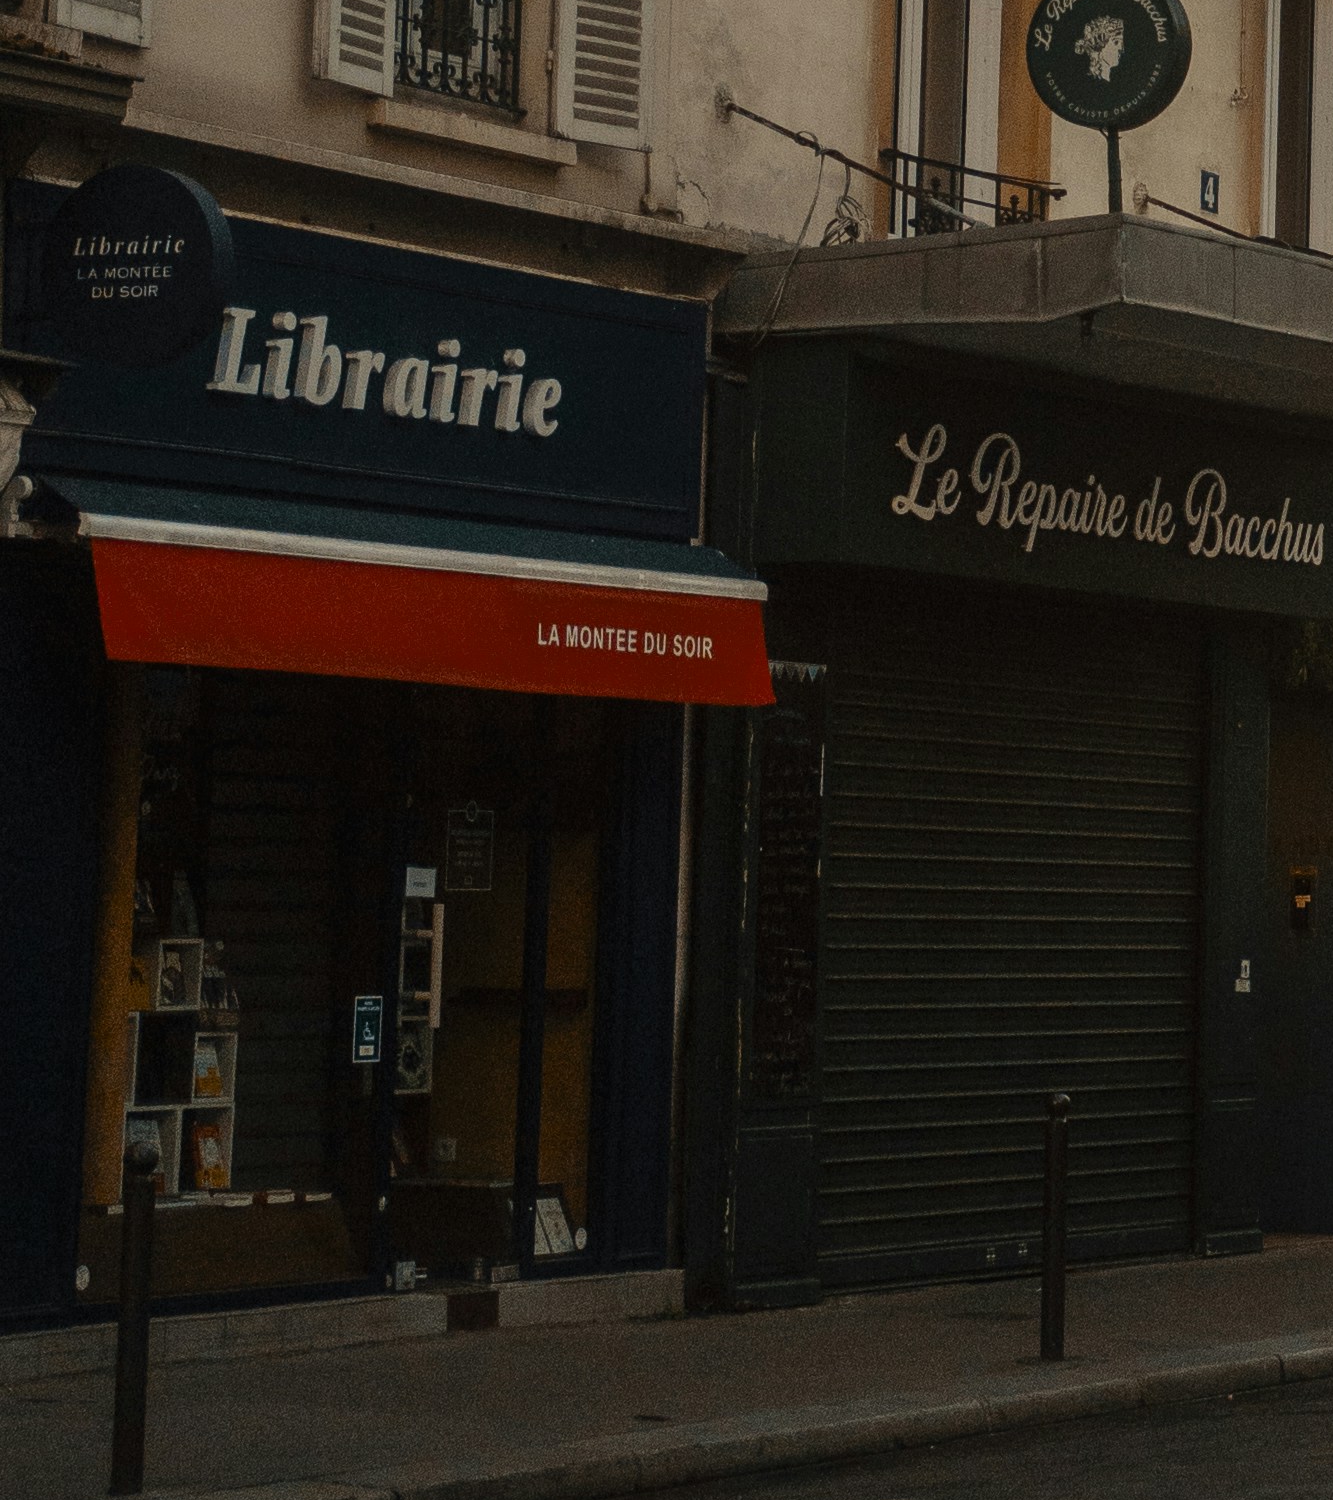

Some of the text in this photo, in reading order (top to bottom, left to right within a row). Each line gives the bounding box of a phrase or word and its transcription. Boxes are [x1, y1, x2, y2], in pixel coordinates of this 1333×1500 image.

[1034, 24, 1053, 51] Le
[1068, 102, 1108, 118] CAVISTE
[1204, 176, 1215, 209] 4
[73, 233, 186, 258] Librairie
[76, 265, 98, 281] LA
[91, 283, 160, 300] DU SOIR
[205, 305, 563, 438] Librairie
[891, 423, 1326, 566] Le Repaire de Bacchus
[537, 622, 714, 660] LA MONTEE DU SOIR
